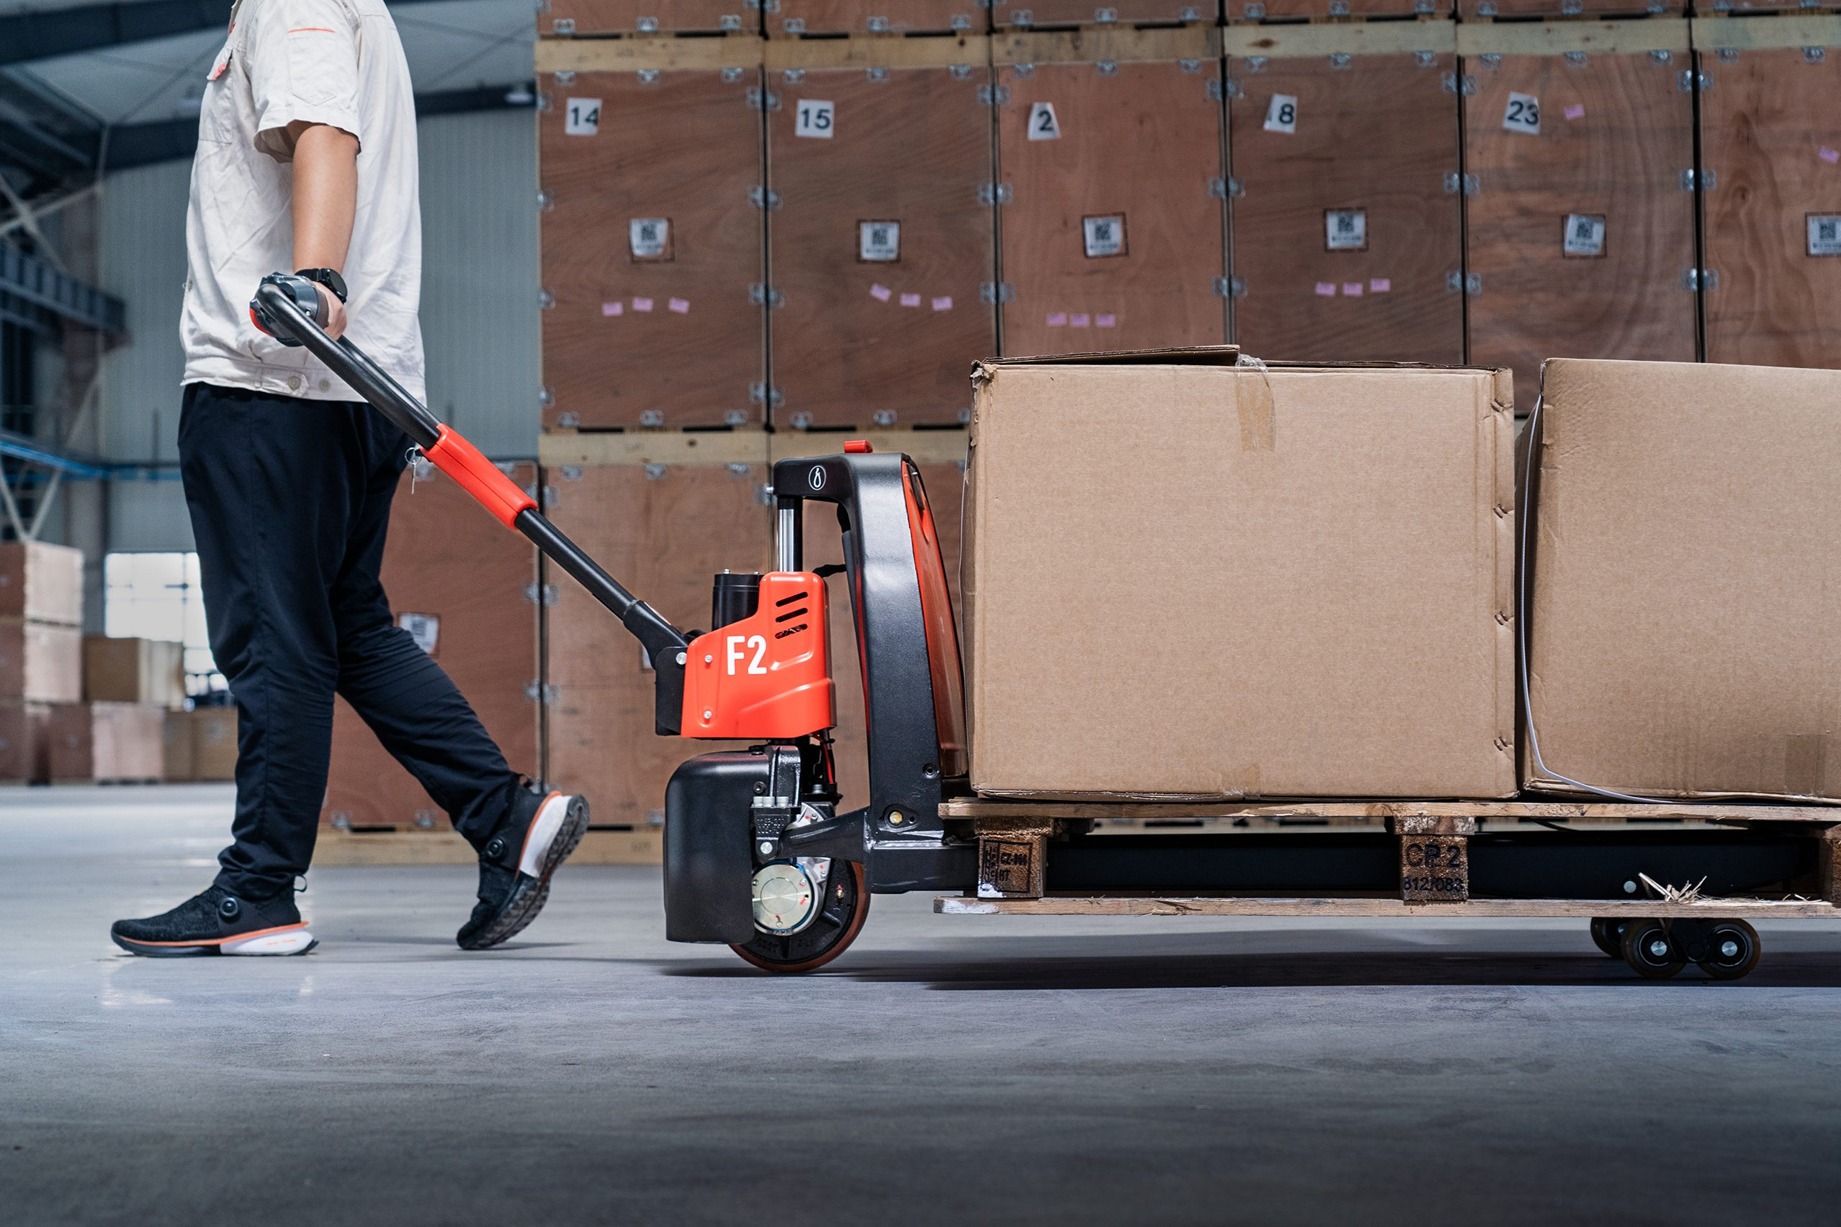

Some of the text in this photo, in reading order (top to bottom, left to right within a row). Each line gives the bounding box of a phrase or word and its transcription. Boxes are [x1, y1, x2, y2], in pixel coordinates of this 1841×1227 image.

[570, 105, 600, 127] 14
[801, 107, 831, 129] 15
[1037, 109, 1054, 131] 2
[1508, 100, 1540, 126] 23
[726, 634, 768, 676] F2
